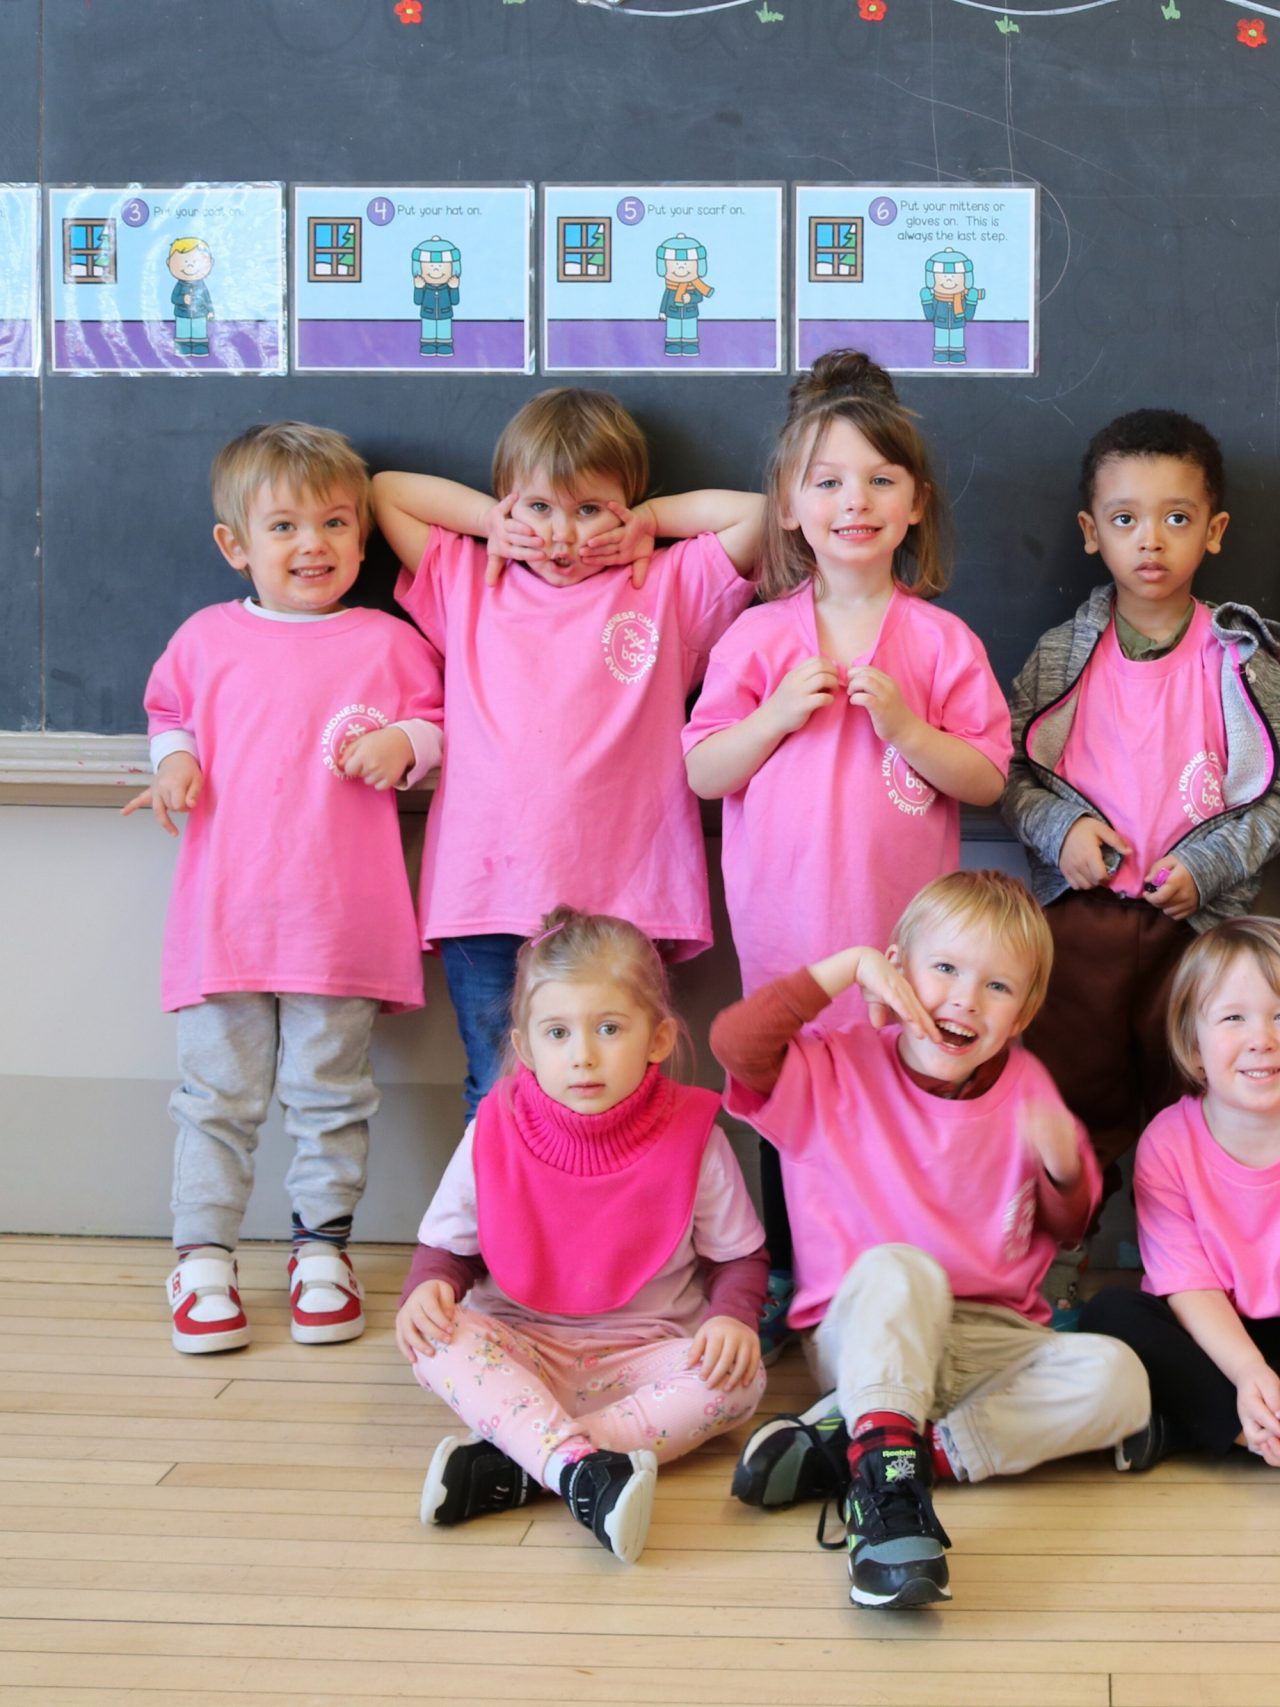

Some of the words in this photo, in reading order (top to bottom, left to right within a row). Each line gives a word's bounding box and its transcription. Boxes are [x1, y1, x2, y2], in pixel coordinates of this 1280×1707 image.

[129, 203, 142, 222] 3
[176, 208, 200, 219] your
[374, 202, 387, 220] 4
[397, 205, 415, 215] Put
[420, 207, 443, 217] your
[446, 205, 463, 215] hat
[467, 207, 482, 215] on.
[624, 201, 637, 220] 5
[647, 204, 666, 215] Put
[670, 207, 694, 217] your
[697, 204, 727, 215] scarf
[730, 207, 745, 215] on.
[877, 201, 890, 220] 6
[900, 200, 919, 211] Put
[923, 203, 946, 213] your
[949, 201, 990, 212] mittens
[993, 203, 1005, 212] or
[906, 216, 940, 228] gloves
[943, 218, 958, 226] on.
[965, 216, 988, 226] This
[991, 216, 1000, 226] is
[897, 231, 933, 243] always
[936, 231, 954, 240] the
[957, 231, 977, 240] last
[981, 232, 1008, 243] step.
[321, 704, 366, 745] KINDNESS
